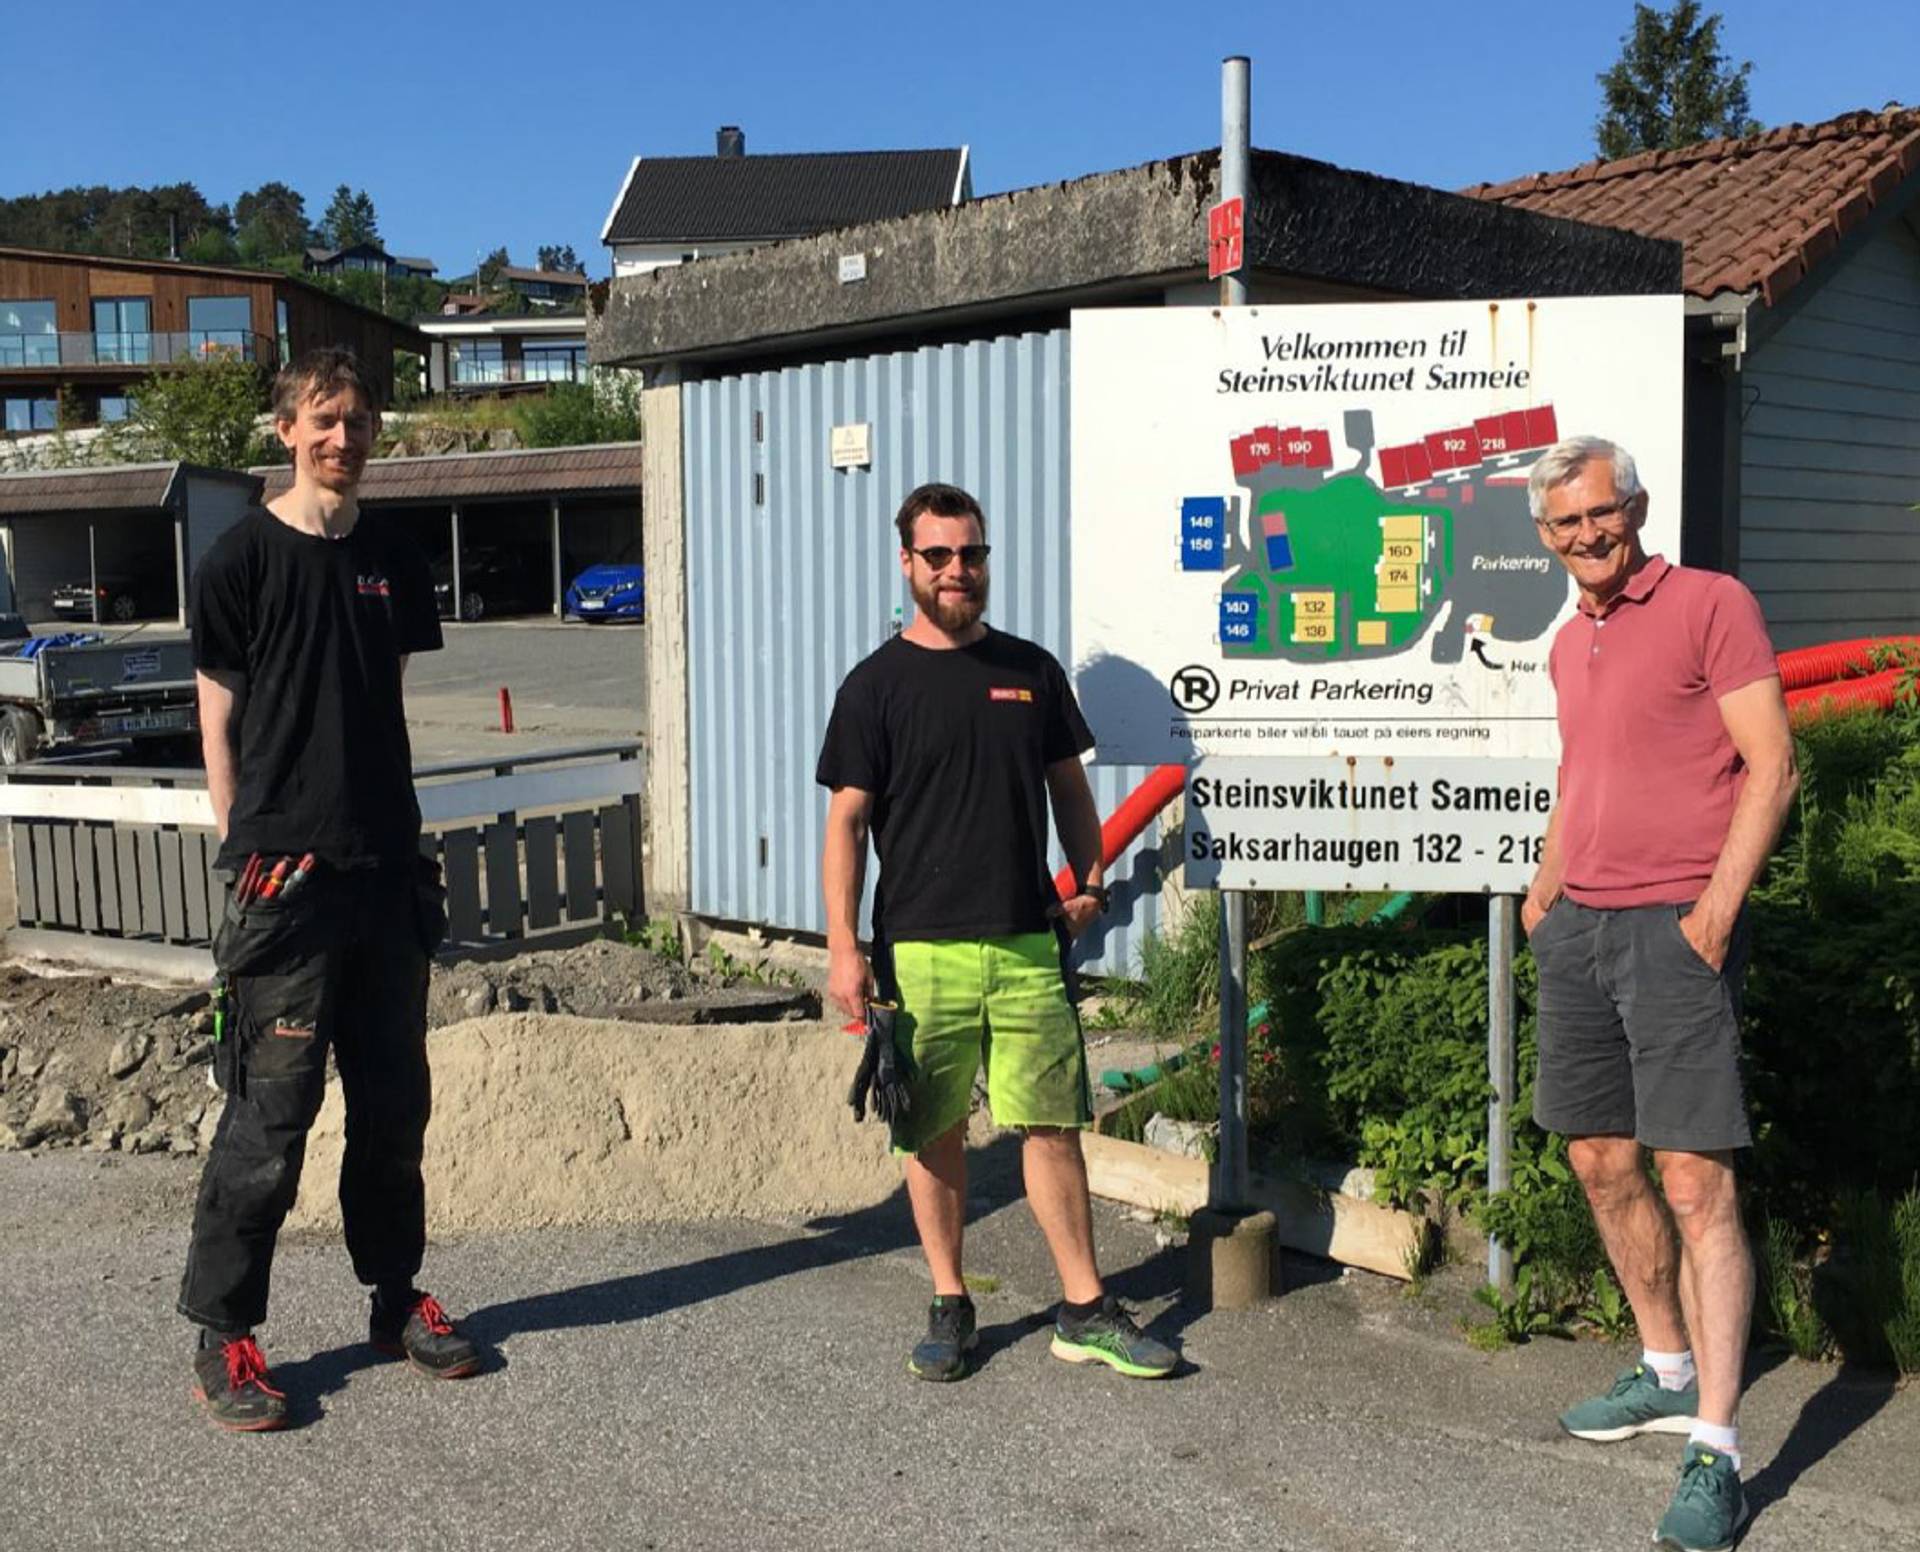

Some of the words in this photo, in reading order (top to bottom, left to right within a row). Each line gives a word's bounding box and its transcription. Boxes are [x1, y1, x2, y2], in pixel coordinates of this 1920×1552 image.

[1261, 332, 1427, 361] Velkommen
[1439, 330, 1467, 357] til
[1217, 364, 1415, 393] Steinsviktunet
[1425, 361, 1530, 390] Sameie
[1250, 442, 1271, 456] 176
[1287, 441, 1312, 453] 190
[1443, 440, 1466, 451] 192
[1388, 545, 1412, 558] 160
[1472, 555, 1550, 573] Parkering
[1389, 569, 1409, 582] 174
[1224, 601, 1249, 614] 140
[1304, 600, 1326, 613] 132
[1229, 679, 1300, 700] Privat
[1310, 679, 1433, 704] Parkering
[1436, 726, 1490, 739] regning
[1192, 777, 1418, 810] Steinsviktunet
[1431, 780, 1551, 811] Sameie
[1192, 831, 1400, 868] Saksarhaugen
[1412, 833, 1462, 863] 132
[1498, 834, 1546, 864] 218
